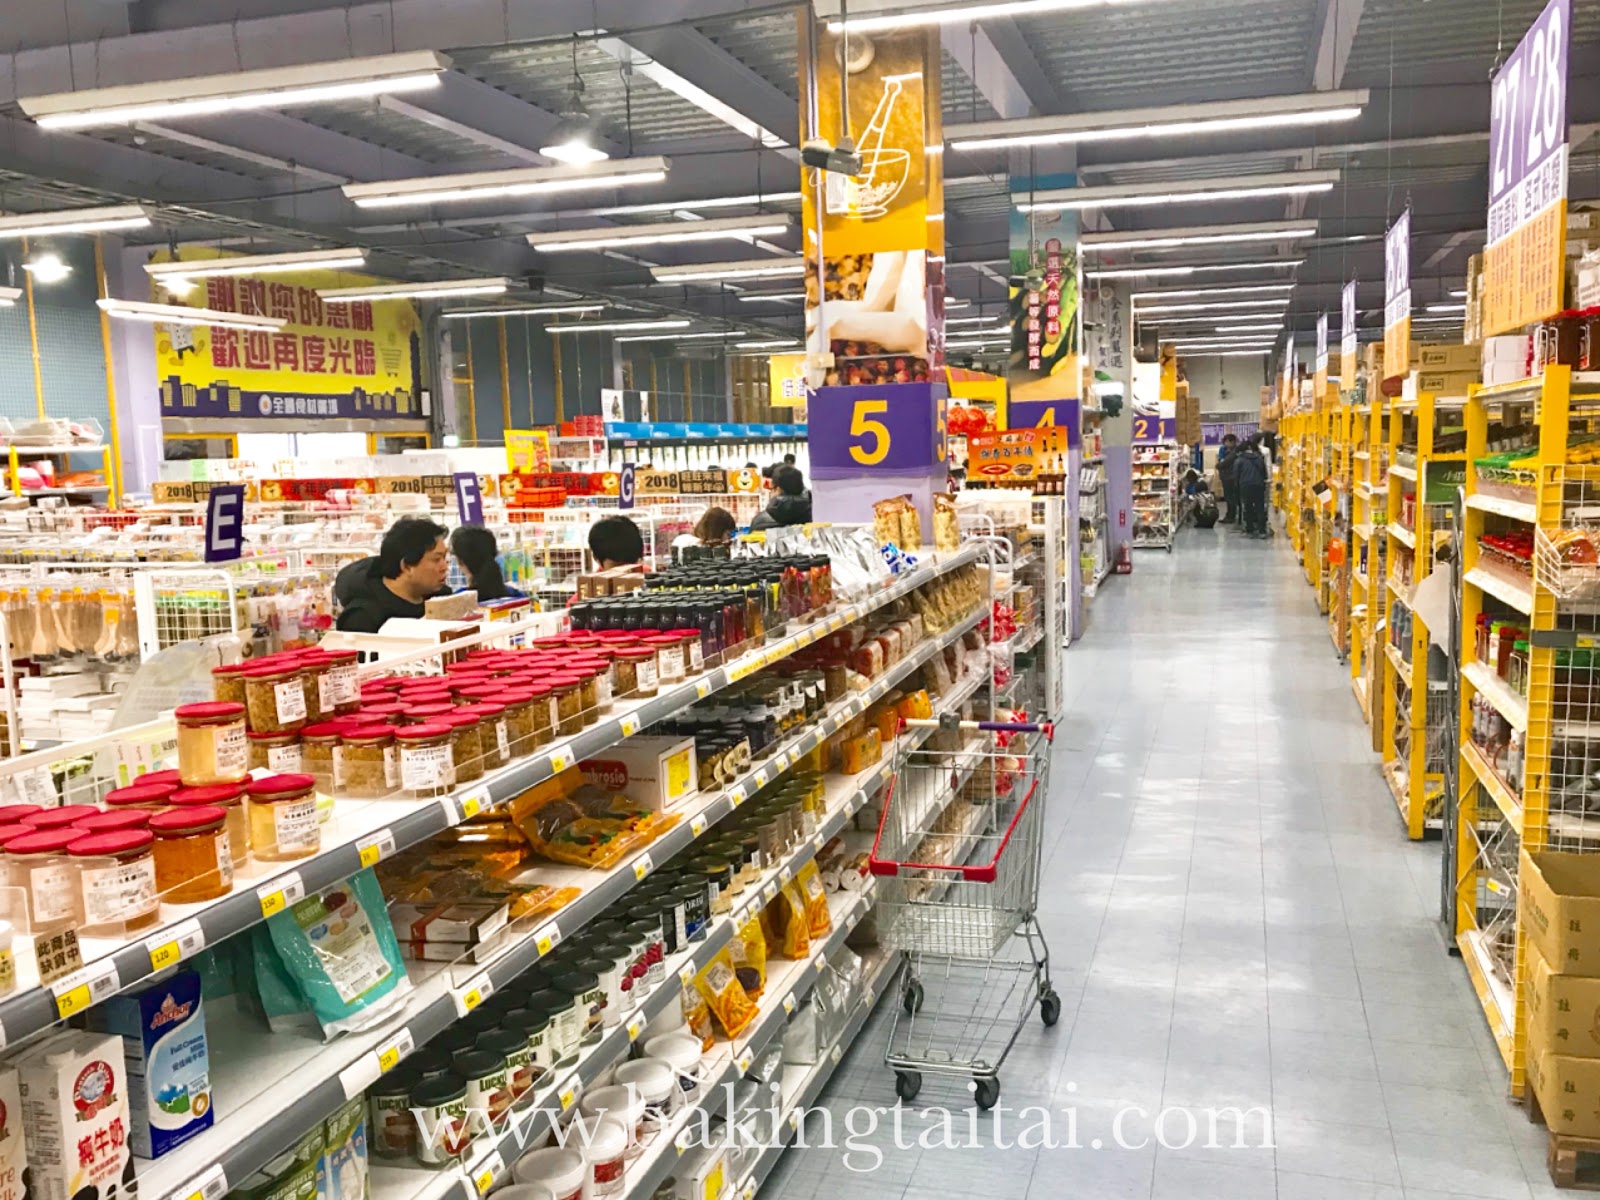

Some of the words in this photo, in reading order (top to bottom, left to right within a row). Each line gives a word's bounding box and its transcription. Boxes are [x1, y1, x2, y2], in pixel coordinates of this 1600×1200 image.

[1493, 58, 1521, 198] 27
[1527, 6, 1562, 167] 28
[211, 326, 376, 376] 歡迎再度光臨
[1036, 407, 1056, 428] 4
[1135, 419, 1149, 439] 2
[849, 400, 891, 465] 5
[167, 484, 193, 498] 2018
[391, 480, 420, 493] 2018
[621, 468, 634, 503] G
[645, 473, 678, 489] 2018
[460, 478, 476, 522] F
[211, 493, 238, 551] E
[38, 929, 76, 958] 此商品
[155, 949, 169, 962] 120
[40, 946, 79, 974] 缺貨中
[61, 996, 73, 1008] 75
[150, 1001, 193, 1030] Anchor
[529, 1034, 544, 1048] EAF
[77, 1117, 125, 1169] 純牛奶
